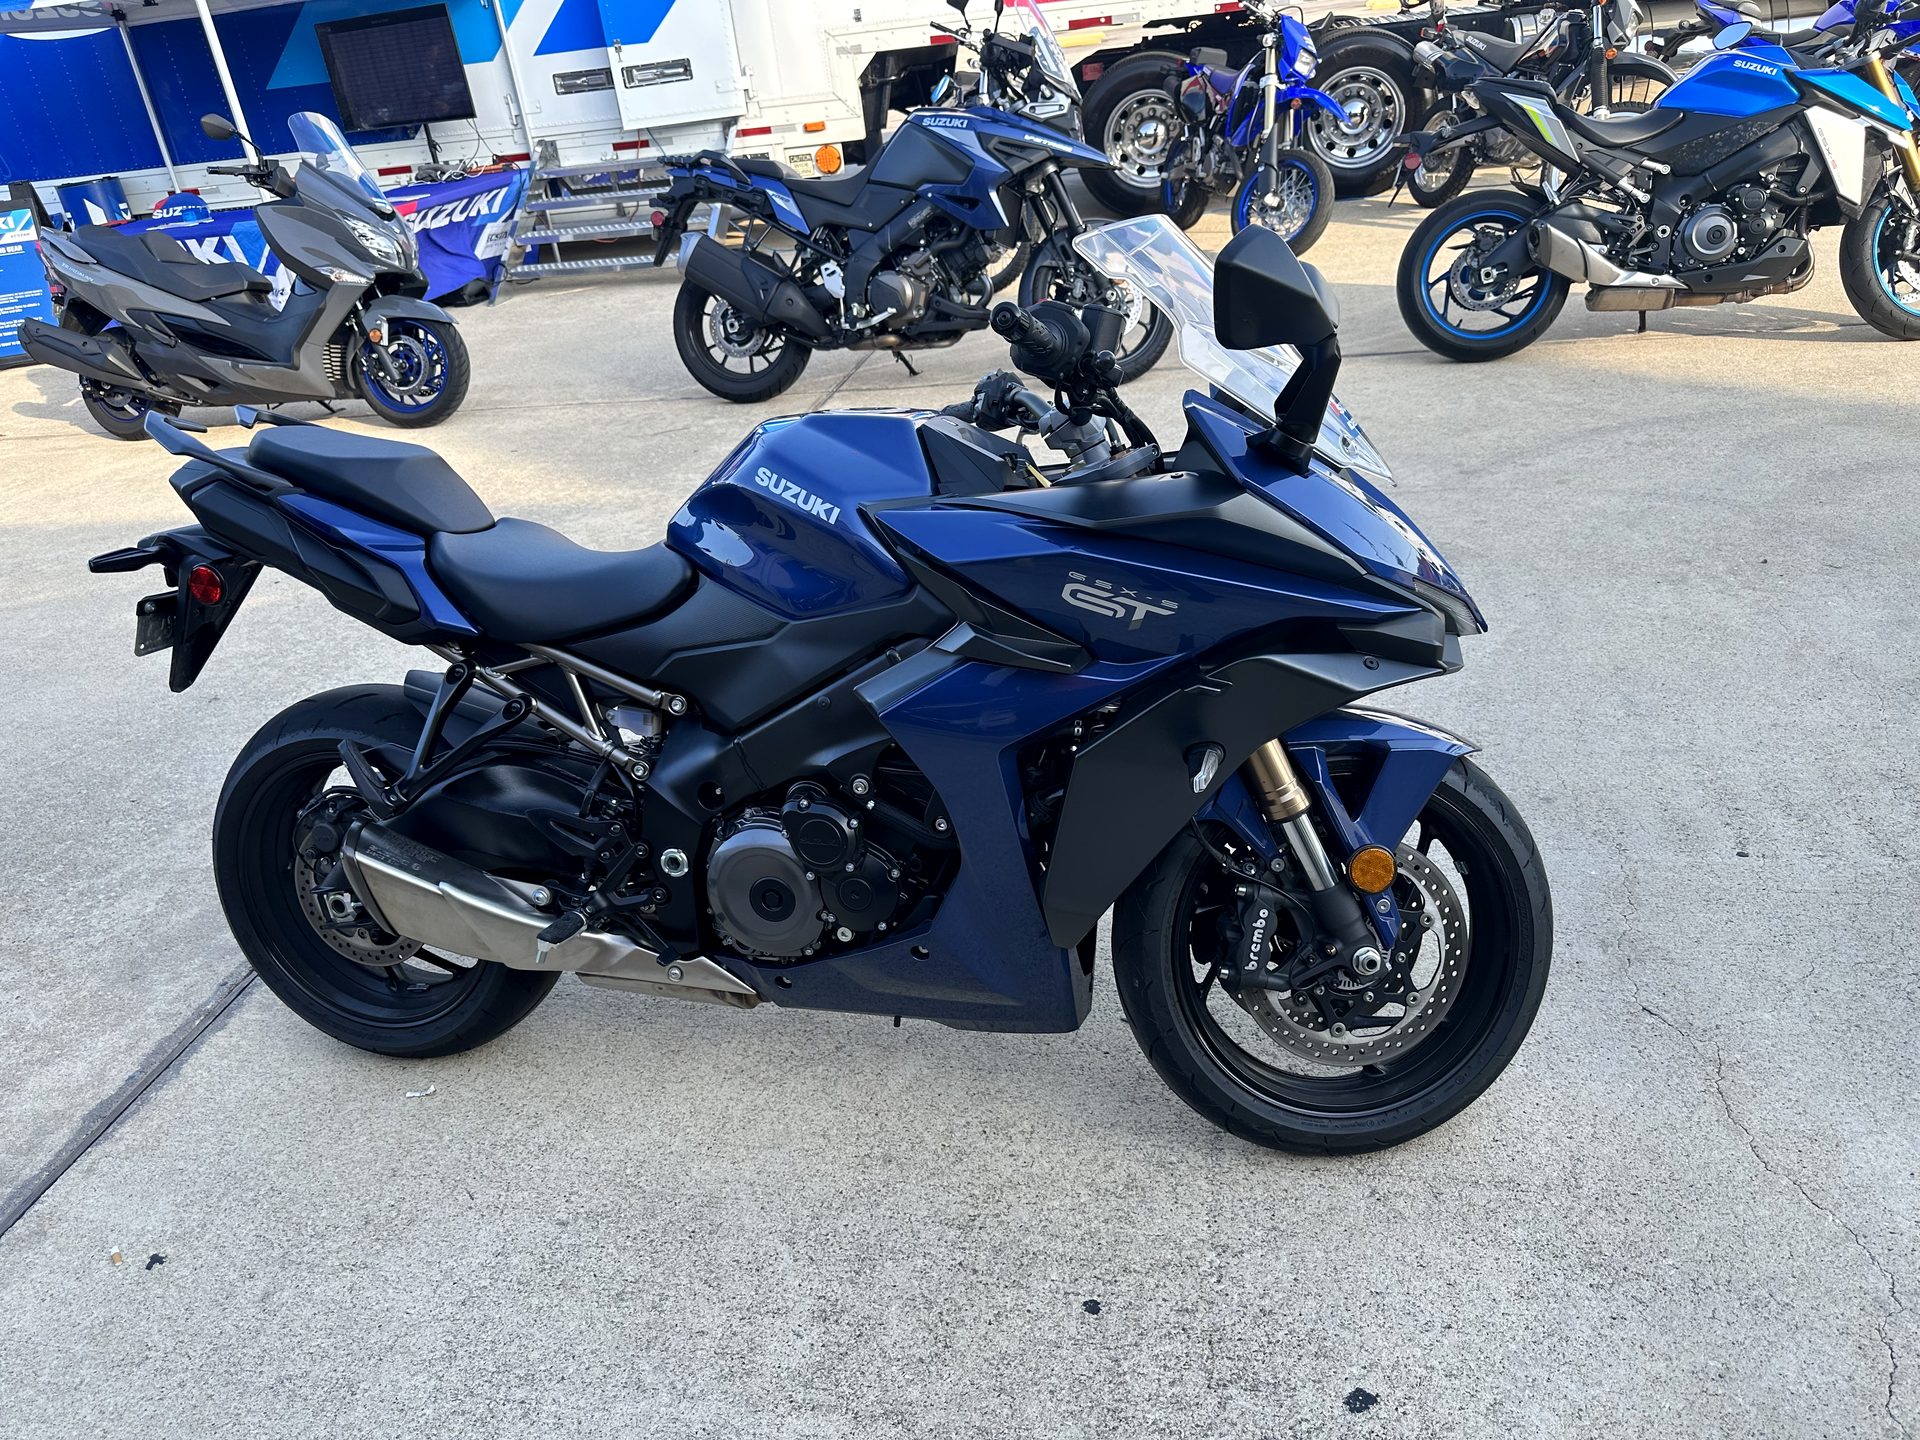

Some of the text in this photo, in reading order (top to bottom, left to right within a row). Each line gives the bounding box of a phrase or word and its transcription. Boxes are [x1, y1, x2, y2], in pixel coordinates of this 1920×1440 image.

[1465, 35, 1488, 51] SUZUKI
[1733, 59, 1778, 76] SUZUKI
[922, 117, 969, 129] SUZUKI
[403, 186, 508, 233] SUZUKI
[755, 466, 841, 525] SUZUKI
[1061, 583, 1176, 632] GT
[1068, 571, 1179, 609] GSX-S
[1244, 908, 1269, 972] brembo
